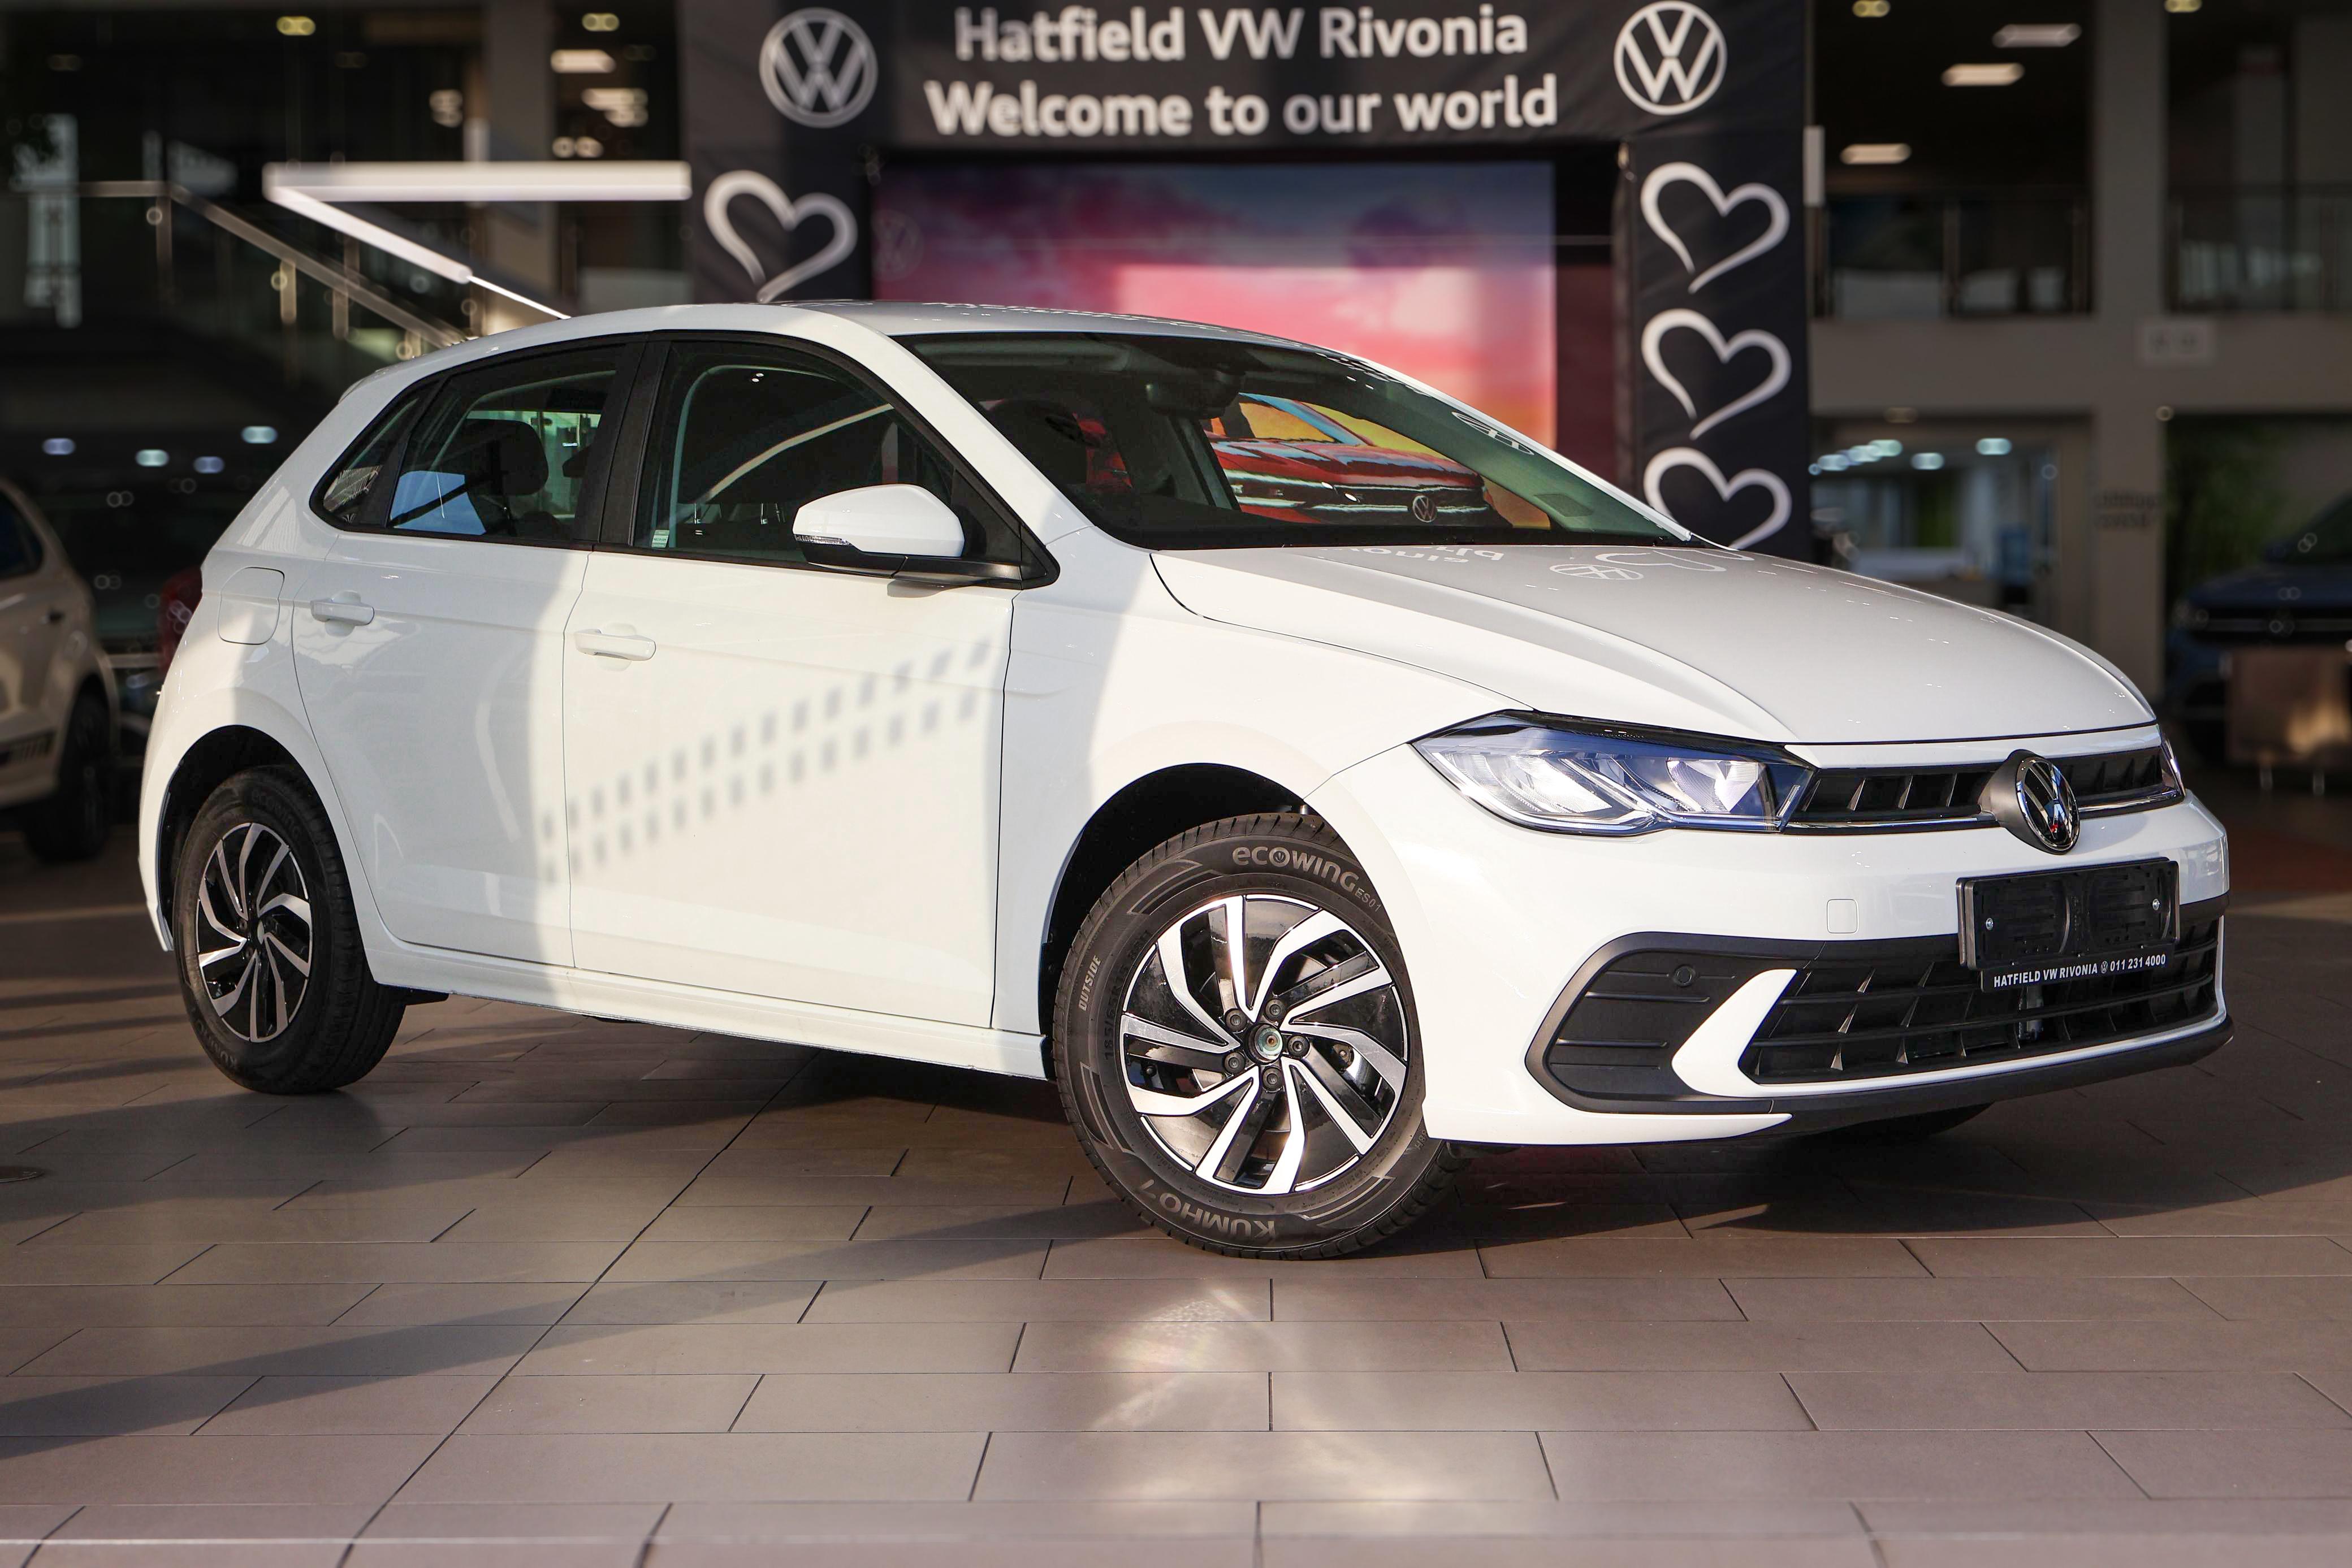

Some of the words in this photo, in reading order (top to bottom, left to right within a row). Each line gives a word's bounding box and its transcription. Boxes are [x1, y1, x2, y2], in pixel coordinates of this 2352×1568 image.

[955, 5, 1186, 62] Hatfield
[1197, 8, 1304, 60] VW
[1320, 4, 1528, 58] Rivonia
[924, 80, 1193, 137] Welcome
[1205, 86, 1270, 136] to
[1282, 93, 1382, 134] our
[1393, 73, 1558, 132] world
[1078, 954, 1102, 1012] OUTSIDE
[1994, 970, 2041, 987] HATFIELD
[2043, 968, 2058, 981] VW
[2059, 963, 2098, 979] RIVONIA
[2110, 959, 2126, 972] 011
[2128, 957, 2143, 969] 231
[2145, 954, 2166, 967] 4000
[1158, 1191, 1276, 1240] KUMHO
